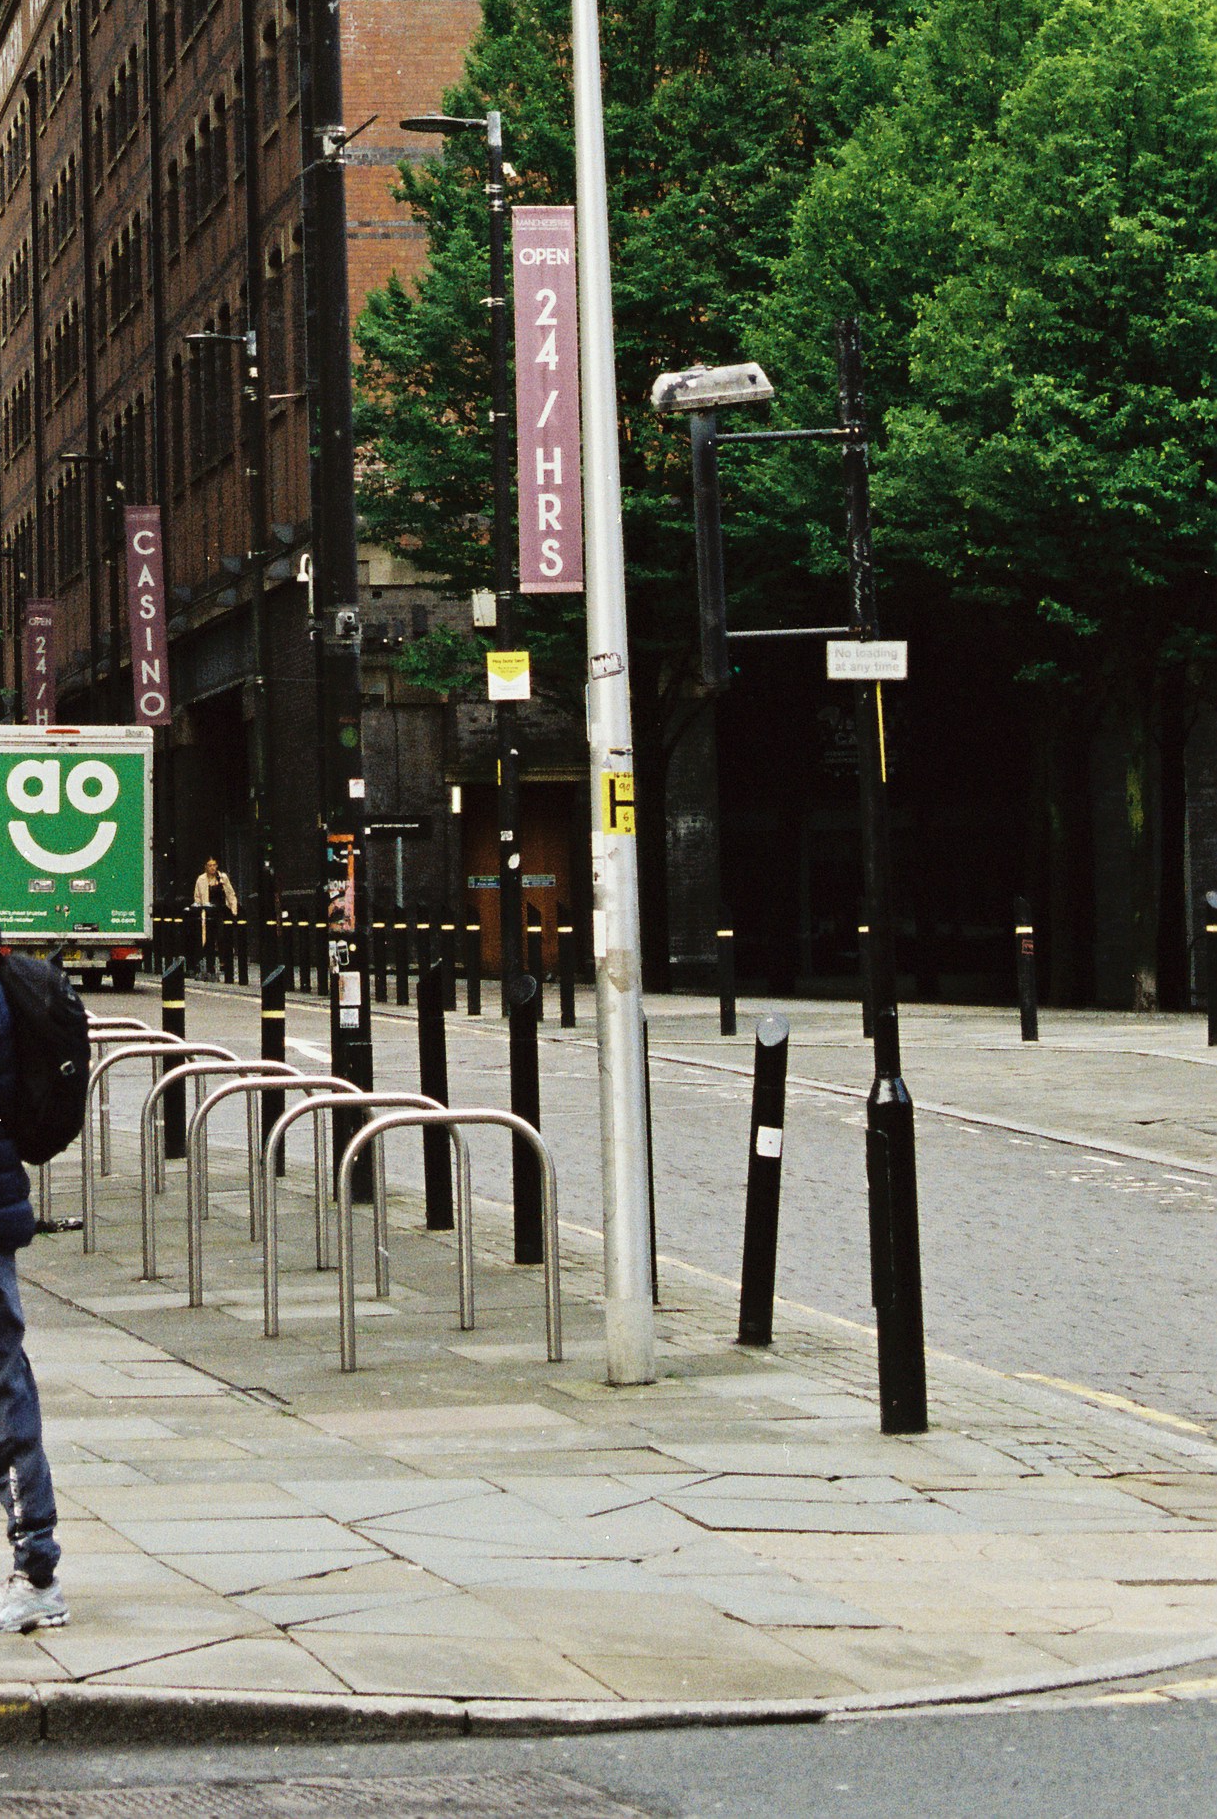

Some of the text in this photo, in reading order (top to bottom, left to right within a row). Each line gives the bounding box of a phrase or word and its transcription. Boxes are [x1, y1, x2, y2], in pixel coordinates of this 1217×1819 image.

[518, 247, 570, 266] OPEN
[28, 616, 52, 628] OPEN
[133, 529, 166, 717] CASINO
[834, 647, 898, 661] No loading
[835, 662, 900, 674] at any time
[5, 758, 120, 815] ao
